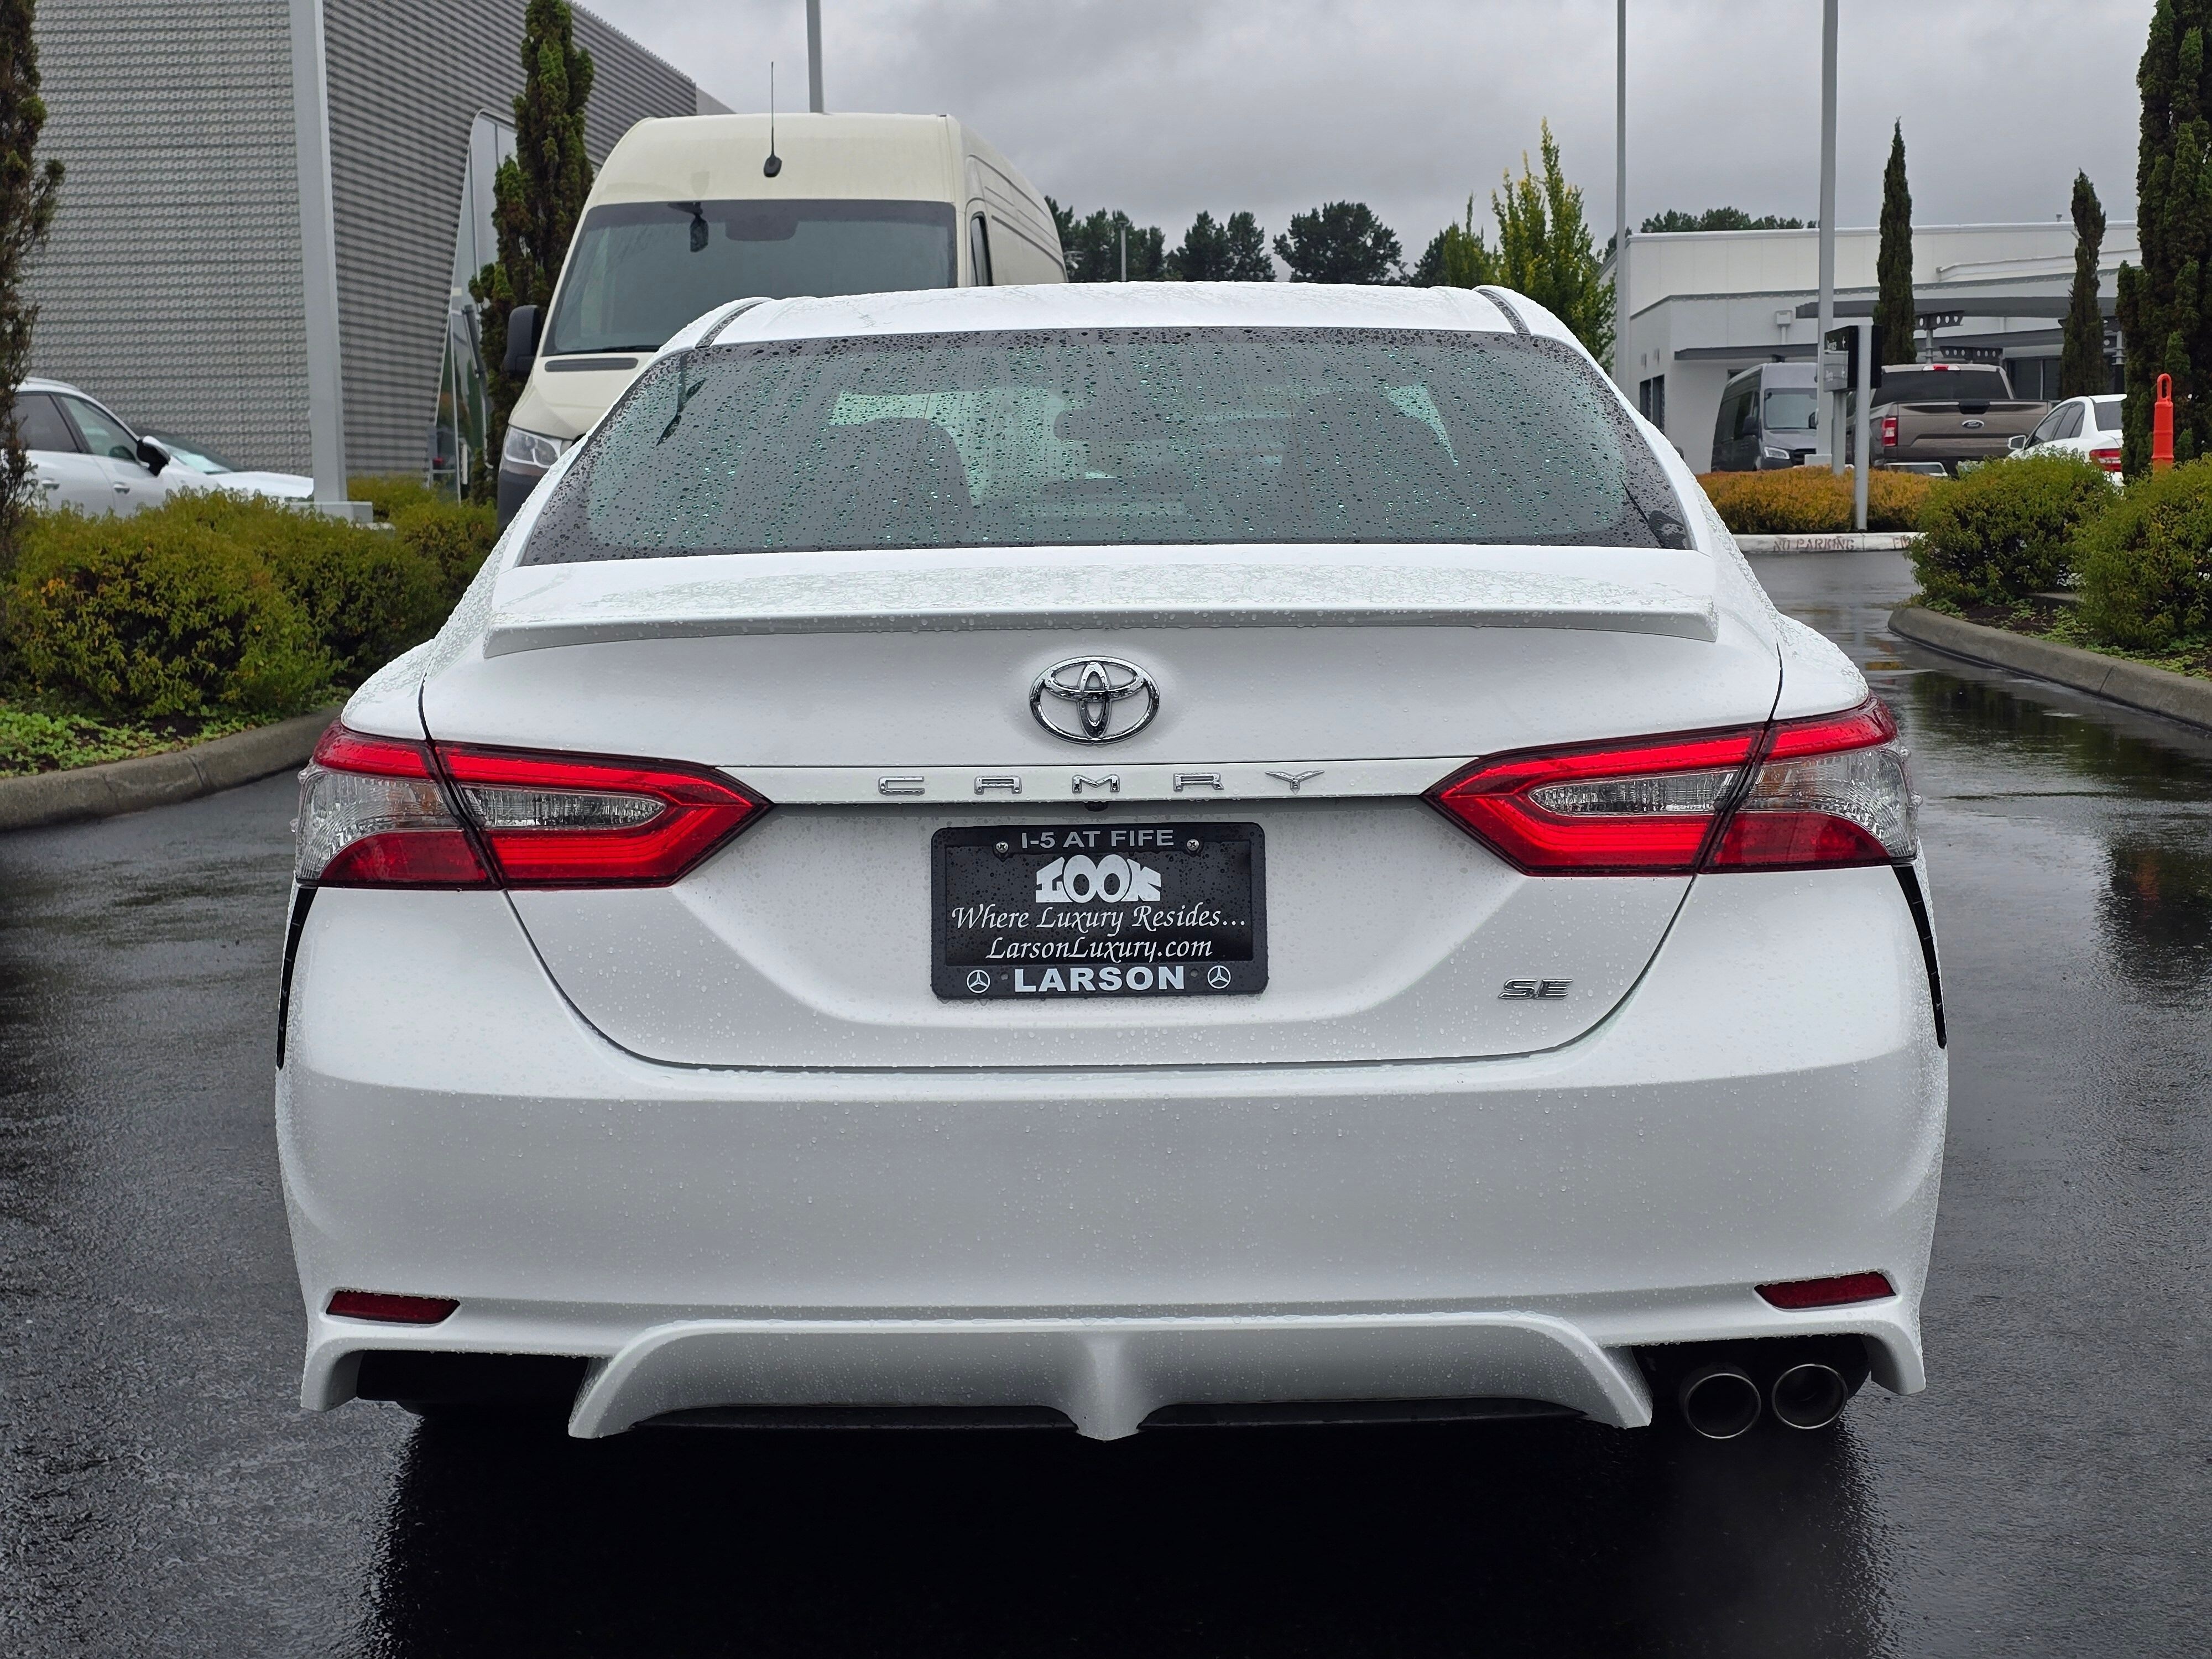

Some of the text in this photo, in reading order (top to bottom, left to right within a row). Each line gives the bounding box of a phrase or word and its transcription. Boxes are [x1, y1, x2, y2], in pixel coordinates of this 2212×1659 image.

[1773, 539, 1791, 551] NO
[1796, 538, 1854, 550] PARKING
[878, 769, 1324, 795] CAMRY
[1022, 830, 1174, 848] I-5 AT FIFE
[1035, 854, 1161, 903] LOOK
[952, 902, 1245, 937] Where Luxury Resides...
[985, 937, 1213, 963] LarsonLuxury.com
[1015, 966, 1185, 992] LARSON
[1498, 978, 1574, 1000] SE
